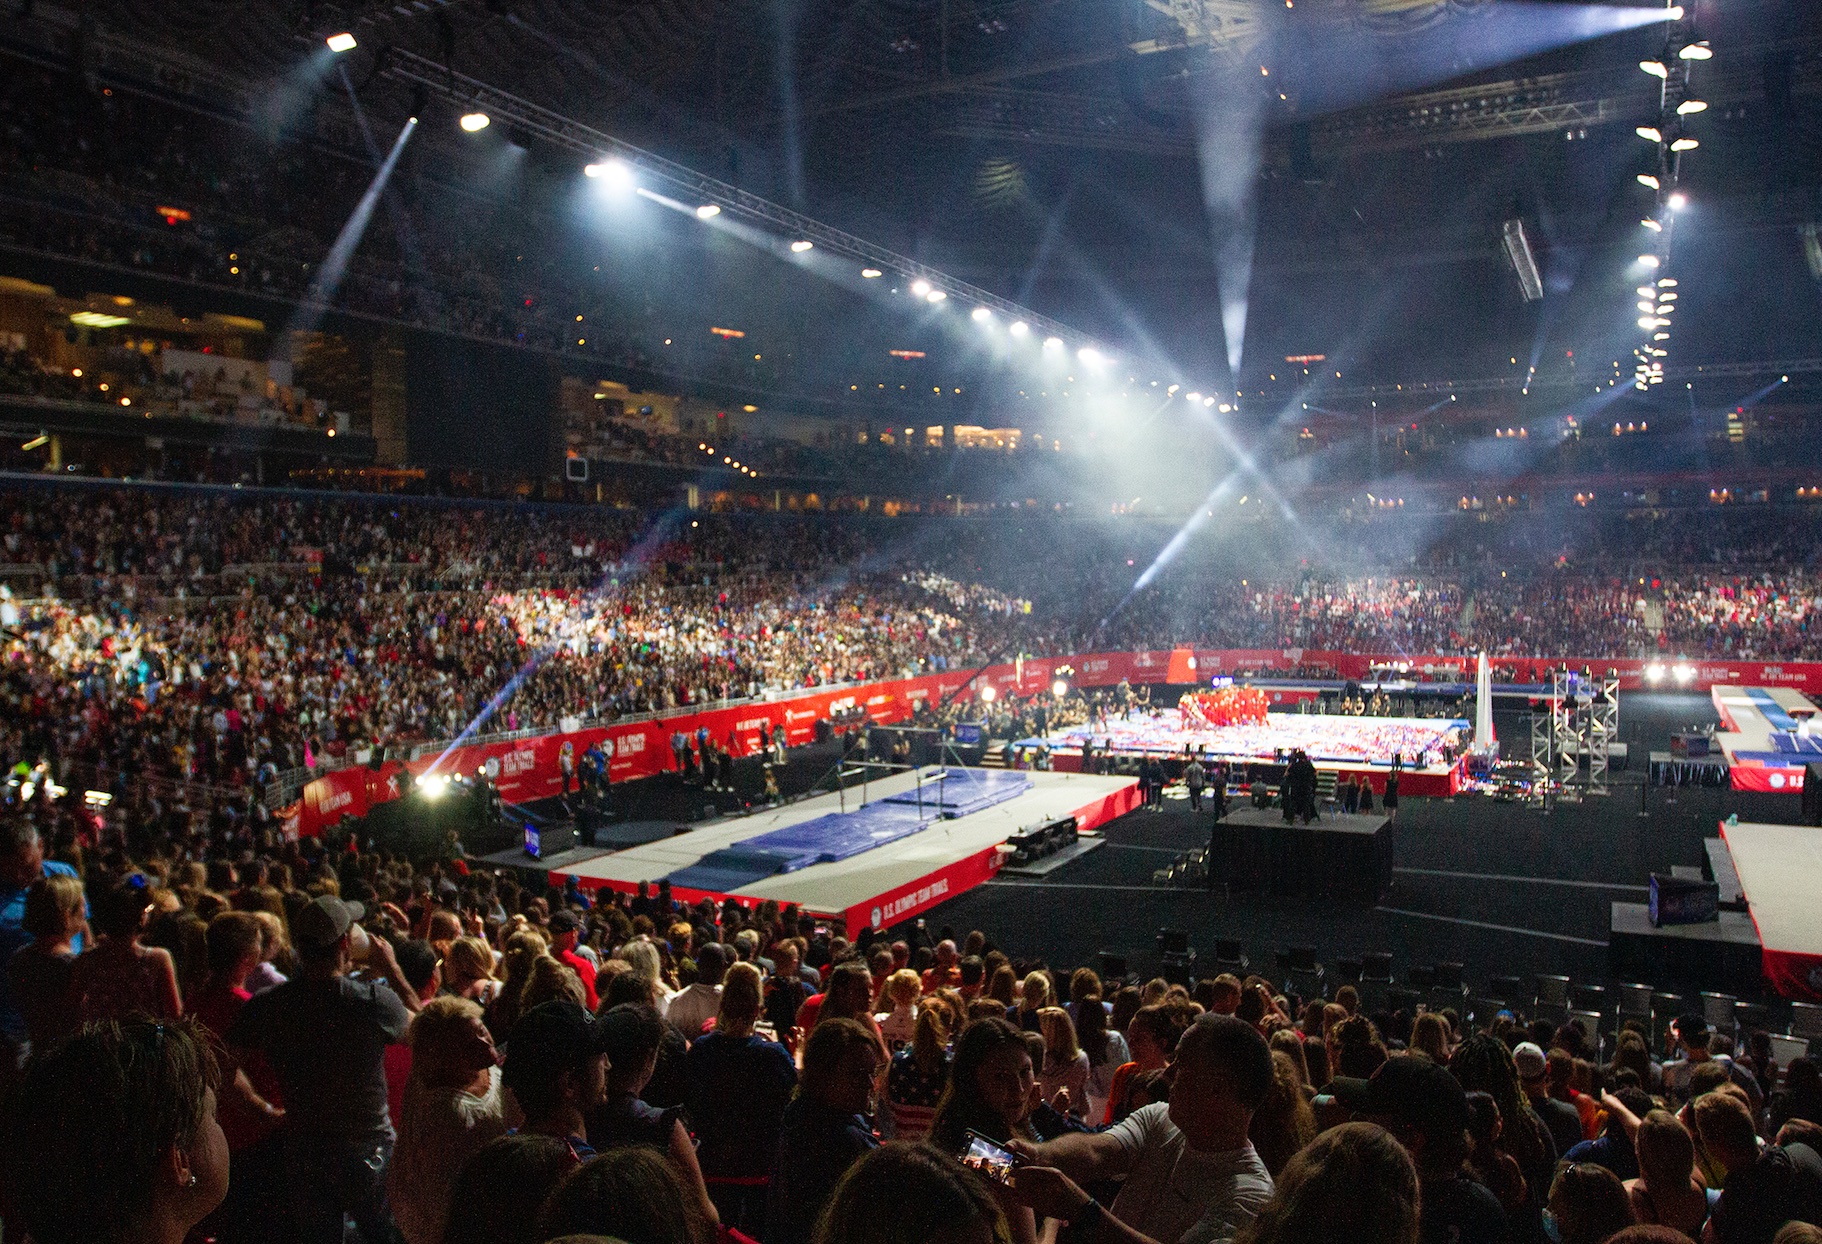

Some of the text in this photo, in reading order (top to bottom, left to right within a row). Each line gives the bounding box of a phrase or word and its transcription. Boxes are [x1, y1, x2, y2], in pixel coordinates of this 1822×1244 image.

[895, 892, 917, 914] OLYMPIC
[917, 886, 930, 904] TEAM
[930, 878, 949, 898] TRIALS
